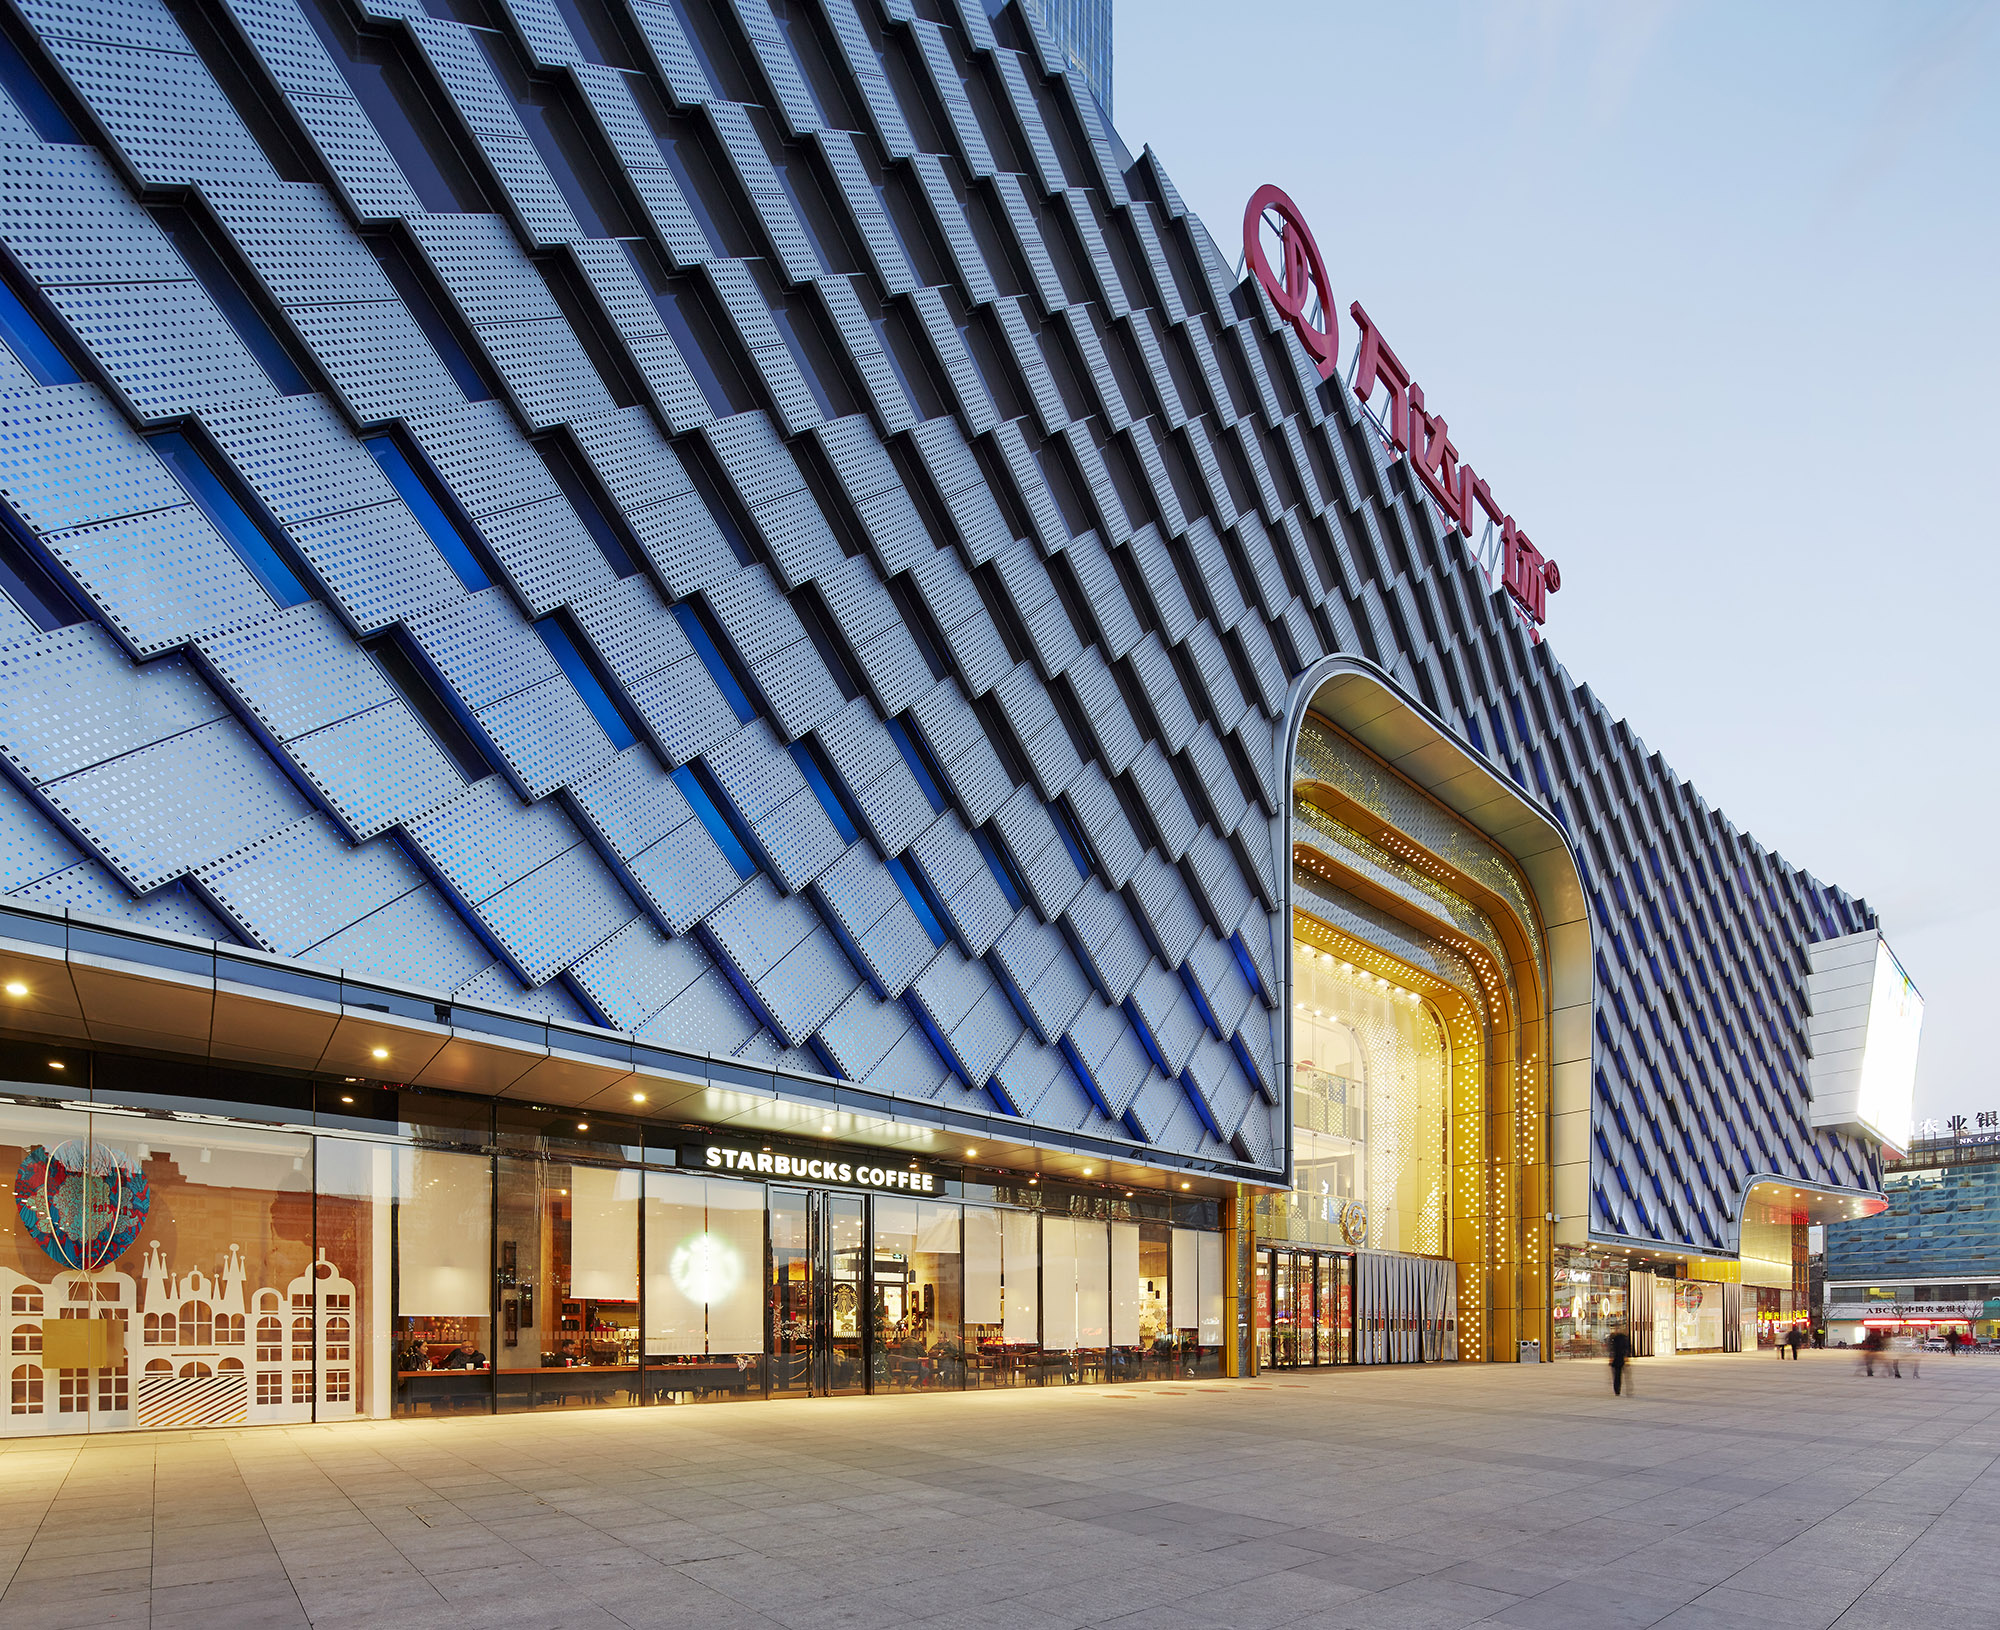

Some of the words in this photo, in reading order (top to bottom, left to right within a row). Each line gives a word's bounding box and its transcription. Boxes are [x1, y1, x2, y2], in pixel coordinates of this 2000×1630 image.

[1350, 299, 1546, 625] 万达广场
[1911, 1110, 2000, 1135] 农业银
[705, 1146, 852, 1183] STARBUCKS
[855, 1166, 933, 1192] COFFEE
[1905, 1305, 1966, 1313] 中国农业银行
